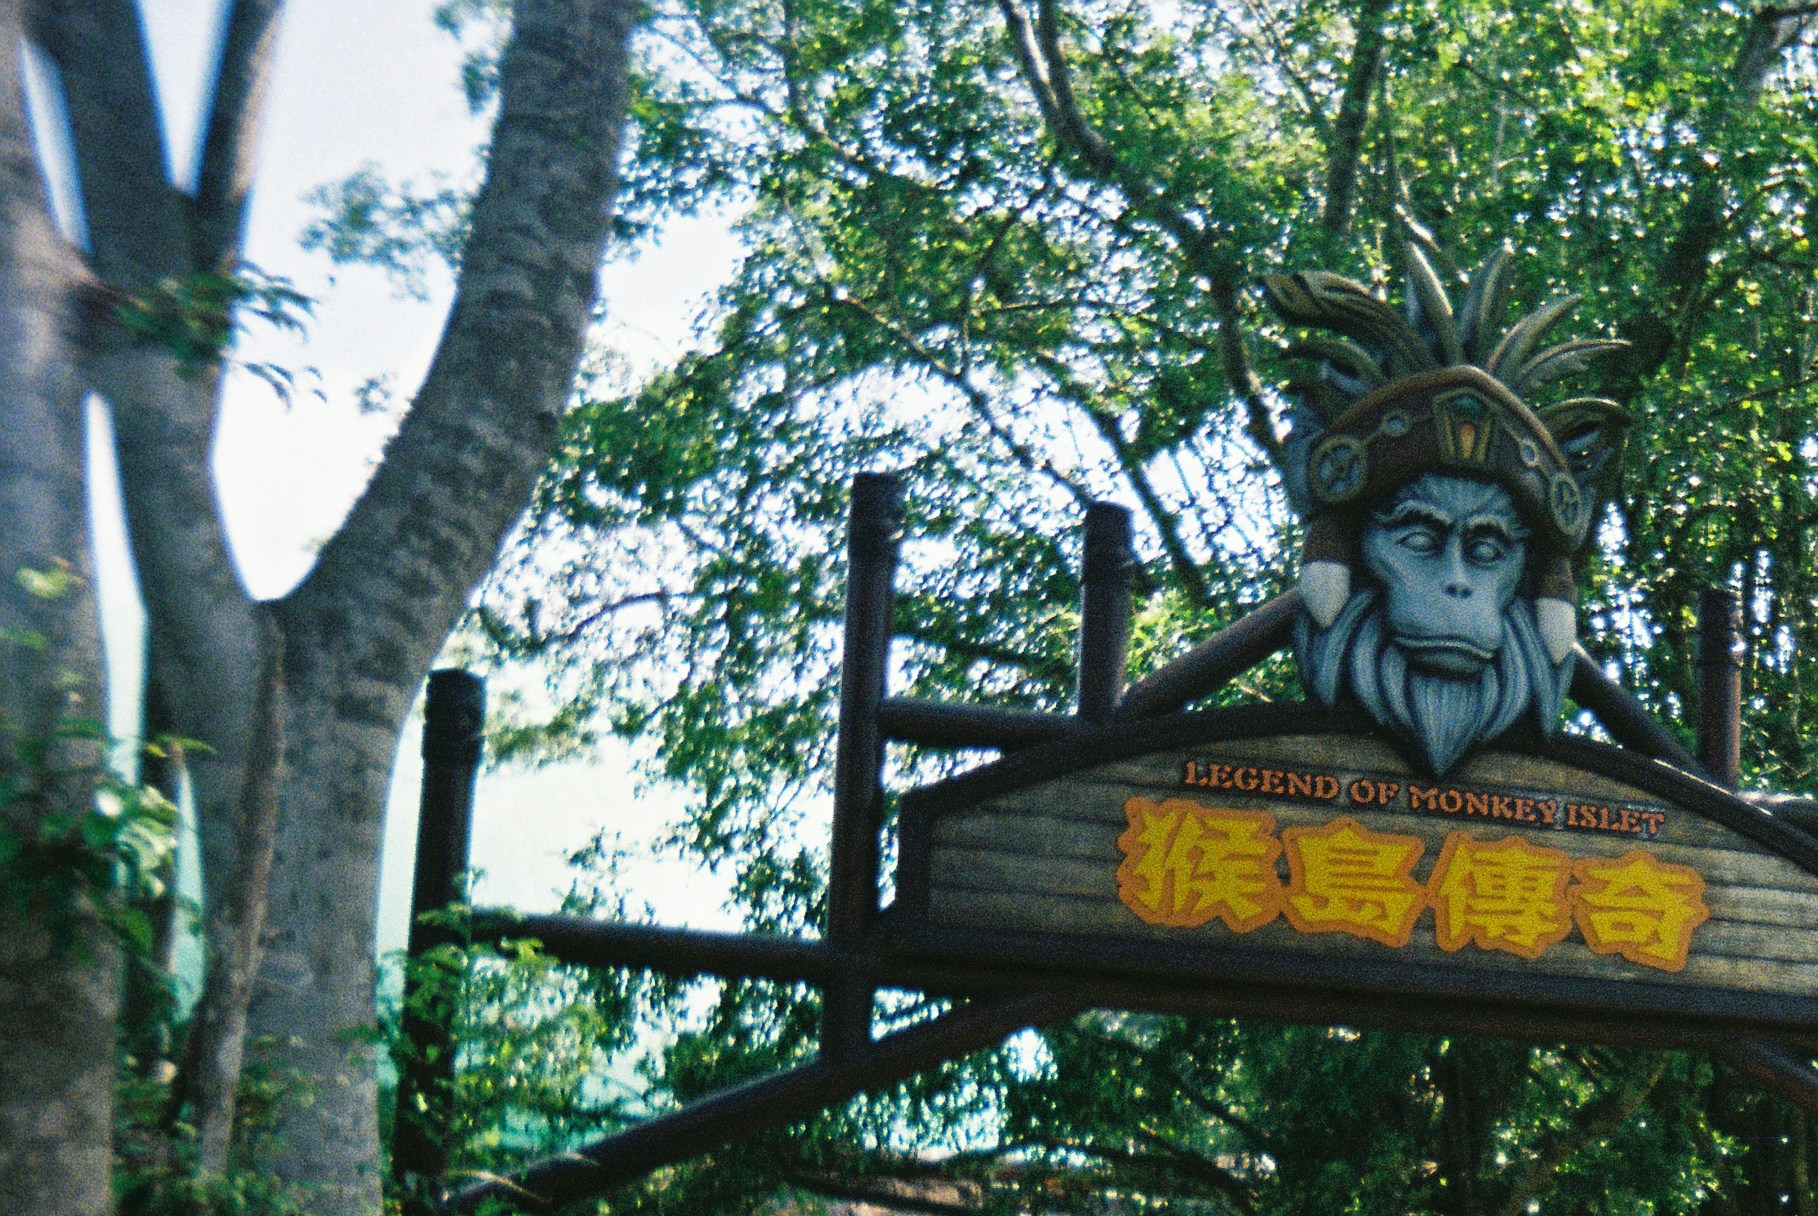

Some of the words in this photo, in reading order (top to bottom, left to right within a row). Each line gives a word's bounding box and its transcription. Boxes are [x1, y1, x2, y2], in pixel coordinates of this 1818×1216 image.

[1184, 760, 1340, 800] LEGEND
[1349, 778, 1400, 805] OF
[1408, 784, 1557, 824] MONKEY
[1565, 803, 1665, 835] ISLET
[1117, 798, 1710, 972] 猴島傳奇
